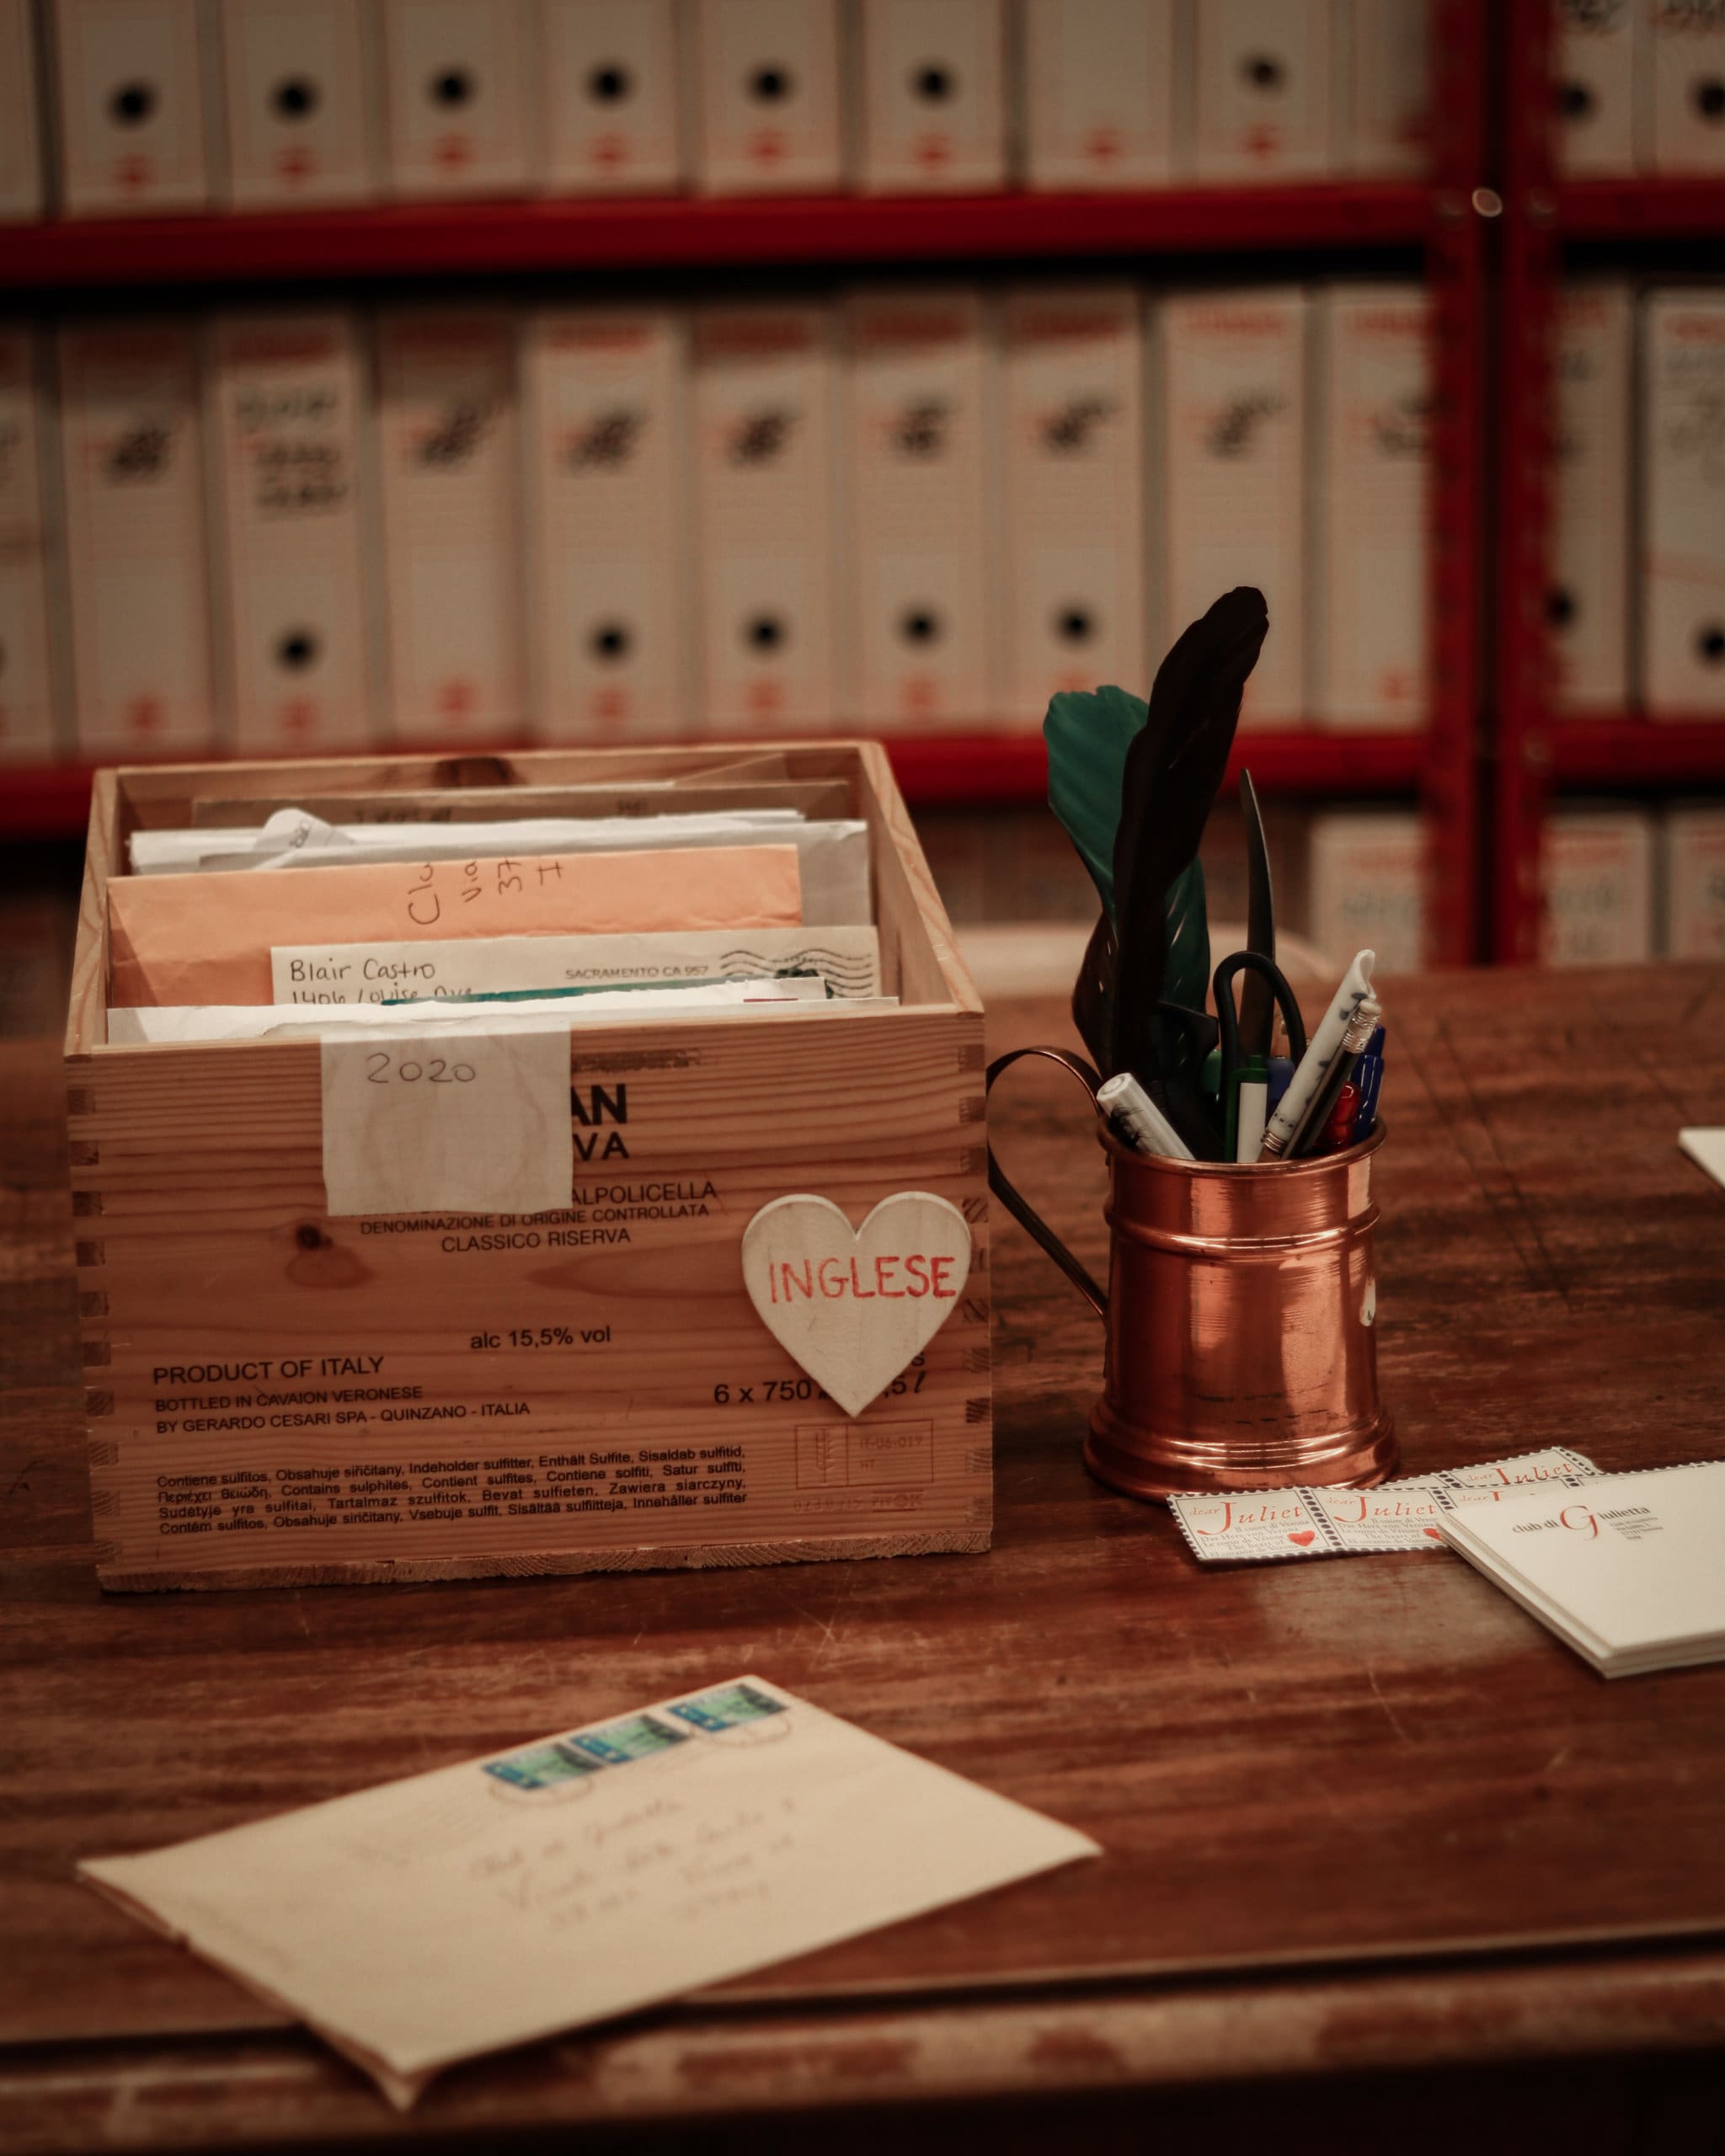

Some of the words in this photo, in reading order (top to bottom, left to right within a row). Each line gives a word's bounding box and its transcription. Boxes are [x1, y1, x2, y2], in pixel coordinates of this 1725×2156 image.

[291, 958, 351, 981] Blair
[364, 958, 435, 980] Castro
[565, 968, 659, 979] SACRAMENTO
[661, 967, 681, 978] CA
[366, 1053, 476, 1083] 2020
[571, 1083, 628, 1126] AN
[573, 1132, 629, 1161] VA
[573, 1180, 717, 1205] ALPOLICELLA
[360, 1214, 494, 1235] DENOMINAZIONE
[500, 1214, 515, 1227] DI
[521, 1210, 587, 1226] ORIGINE
[592, 1203, 709, 1223] CONTROLLATA
[441, 1232, 541, 1252] CLASSICO
[547, 1228, 631, 1246] RISERVA
[770, 1255, 957, 1304] INGLESE
[471, 1331, 501, 1348] alc
[509, 1327, 574, 1348] 15,5%
[580, 1326, 611, 1343] vol
[153, 1362, 273, 1384] PRODUCT
[280, 1359, 312, 1378] OF
[322, 1357, 384, 1376] ITALY
[155, 1396, 231, 1412] BOTTLED
[236, 1395, 252, 1407] IN
[256, 1390, 327, 1406] CAVAION
[332, 1386, 423, 1401] VERONESE
[714, 1384, 729, 1404] 6
[739, 1387, 753, 1402] x
[763, 1380, 811, 1401] 750
[157, 1421, 178, 1433] BY
[183, 1416, 265, 1432] GERARDO
[270, 1412, 331, 1428] CESARI
[336, 1411, 367, 1423] SPA
[381, 1405, 467, 1422] QUINZANO
[481, 1402, 531, 1416] ITALIA
[157, 1475, 216, 1488] Contiene
[222, 1471, 271, 1484] sulfitos,
[276, 1465, 339, 1482] Obsahuje
[409, 1460, 479, 1474] Indeholder
[539, 1454, 585, 1467] Enthält
[590, 1451, 633, 1465] Sulfite,
[638, 1449, 695, 1462] Sisaldab
[281, 1484, 340, 1497] Contains
[422, 1476, 478, 1489] Contient
[547, 1470, 606, 1482] Contiene
[664, 1464, 698, 1476] Satur
[232, 1504, 254, 1517] yra
[328, 1496, 397, 1510] Tartalmaz
[483, 1489, 523, 1502] Bevat
[610, 1482, 665, 1495] Zawiera
[274, 1514, 337, 1529] Obsahuje
[409, 1507, 462, 1521] Vsebuje
[703, 1492, 747, 1505] sulfiter
[1189, 1507, 1221, 1516] dear
[1333, 1495, 1436, 1523] Juliet
[1197, 1502, 1302, 1535] Juliet
[1512, 1521, 1542, 1534] club
[1544, 1518, 1561, 1529] di
[1559, 1505, 1651, 1540] Giulietta
